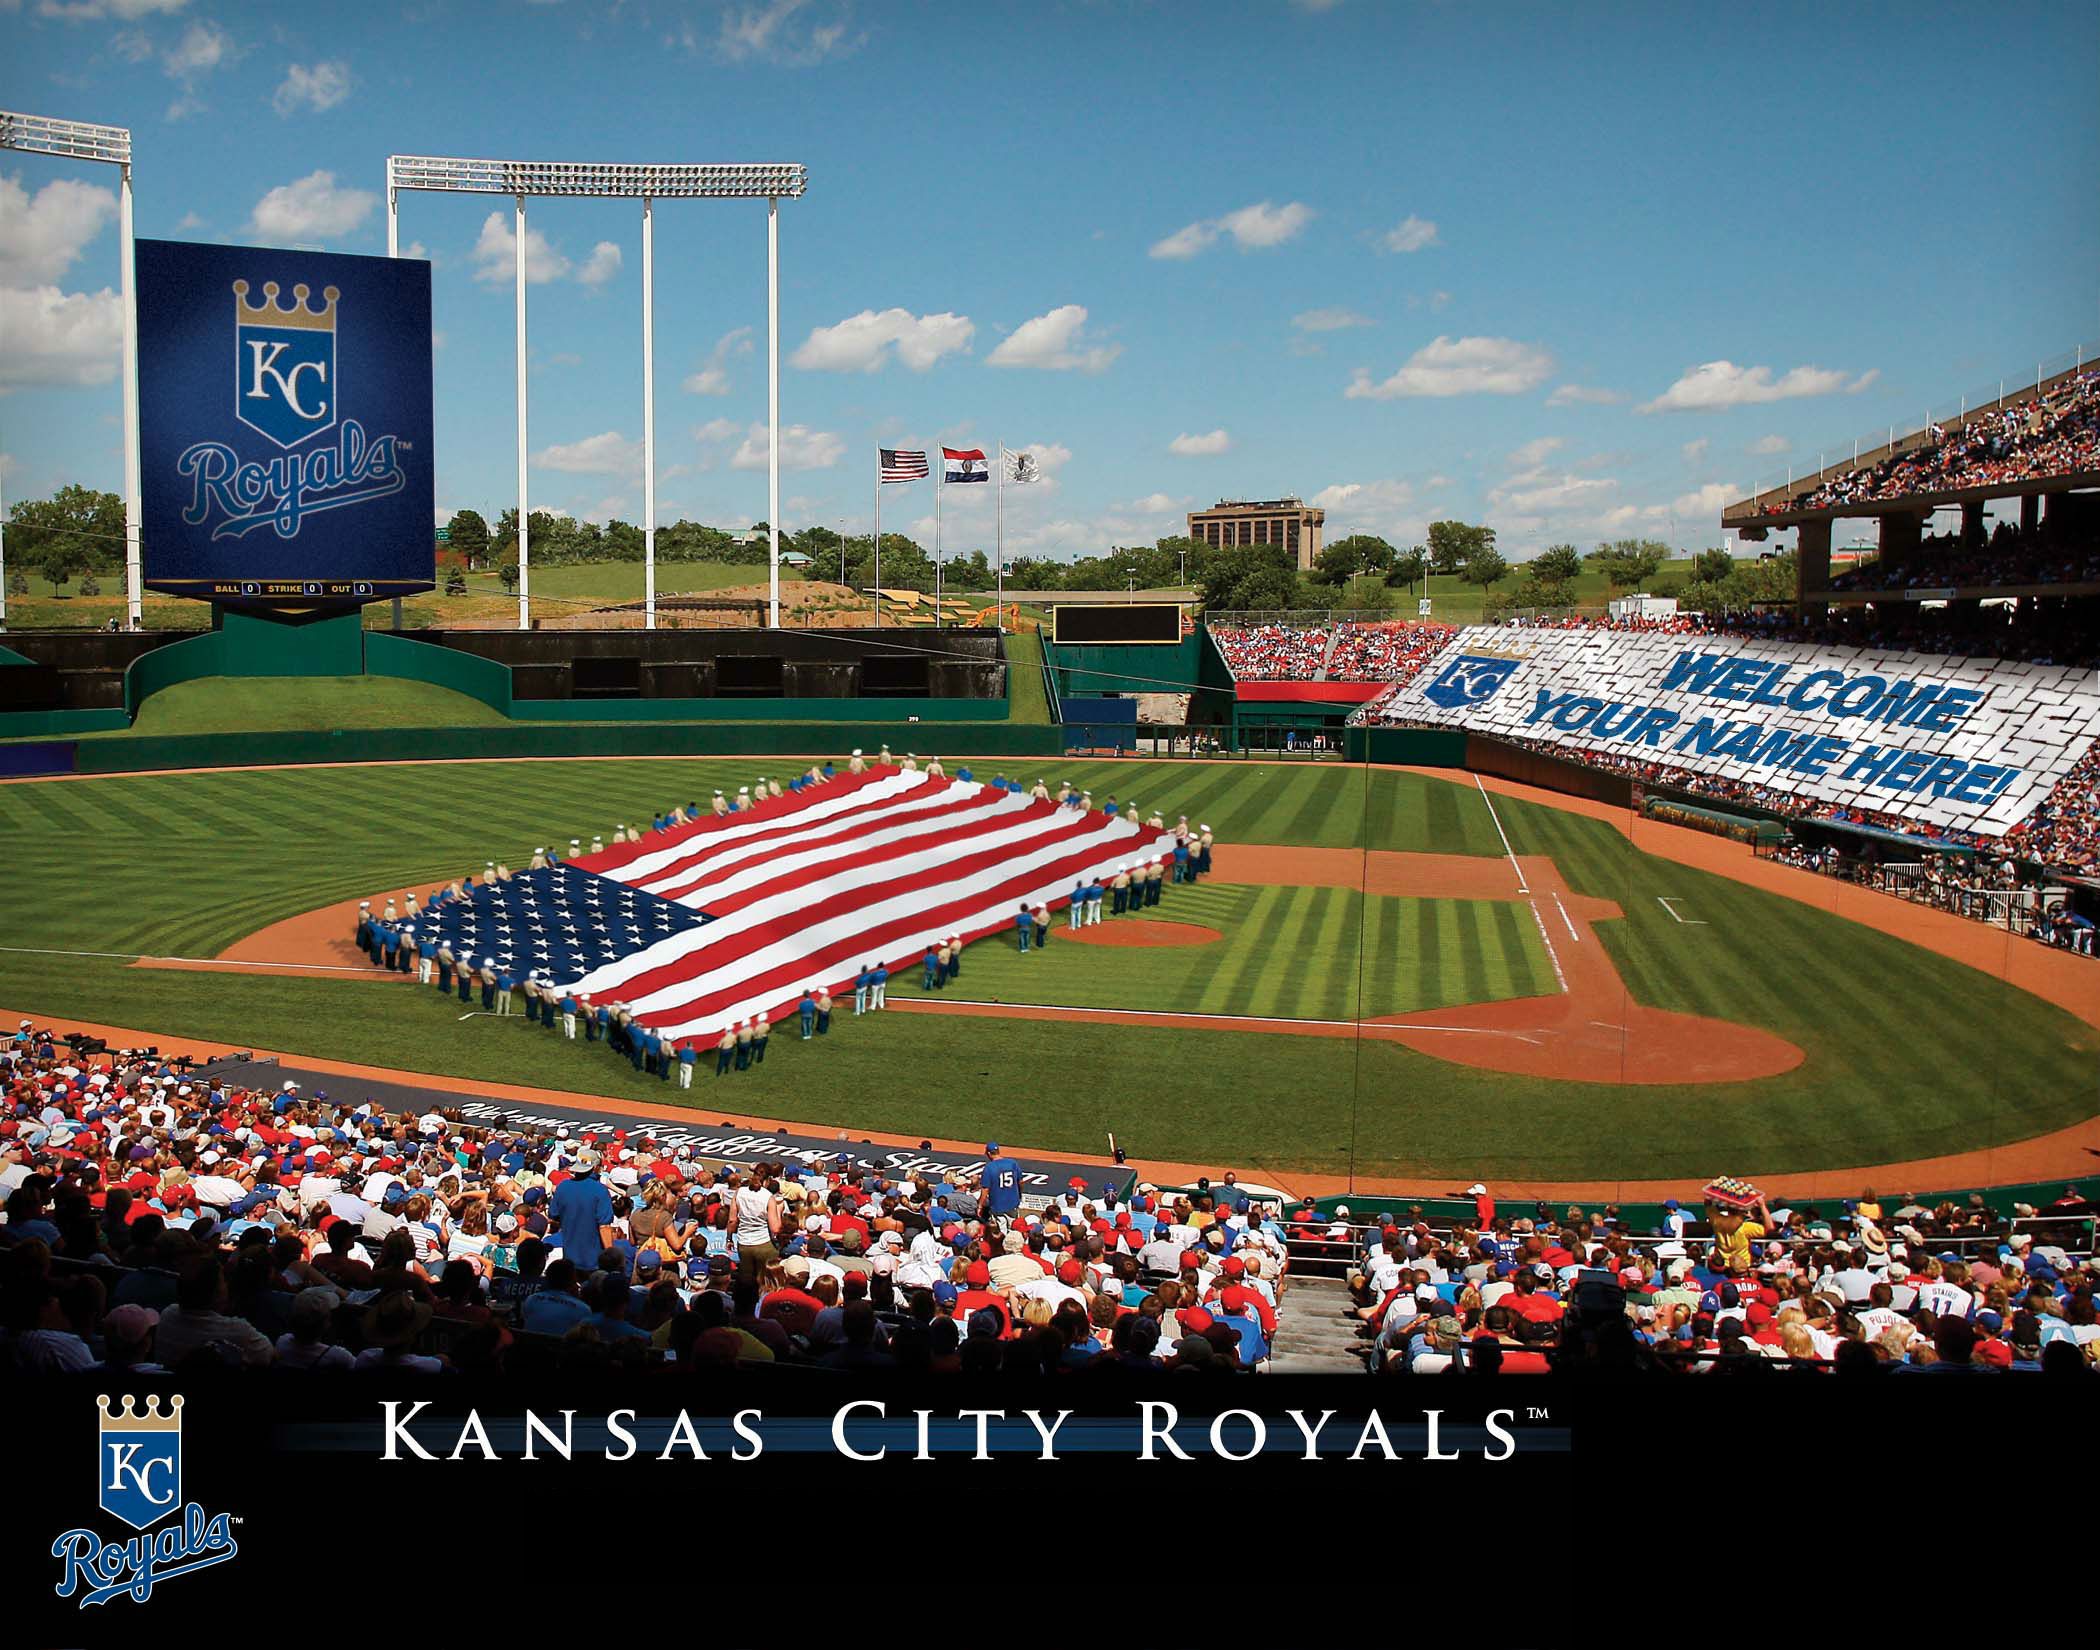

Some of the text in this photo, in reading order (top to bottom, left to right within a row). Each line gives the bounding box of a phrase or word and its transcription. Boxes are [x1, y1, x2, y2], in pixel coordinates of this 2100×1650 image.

[246, 340, 328, 420] KC
[177, 419, 405, 540] Royals
[215, 584, 366, 593] BALL 0 STRIKE 0 OUT 0
[1437, 661, 1506, 699] KC
[1659, 650, 1986, 734] WELCOME
[1523, 689, 2023, 805] YOUR NAME HERE!
[999, 1171, 1014, 1188] 15
[1932, 1297, 1952, 1315] 11
